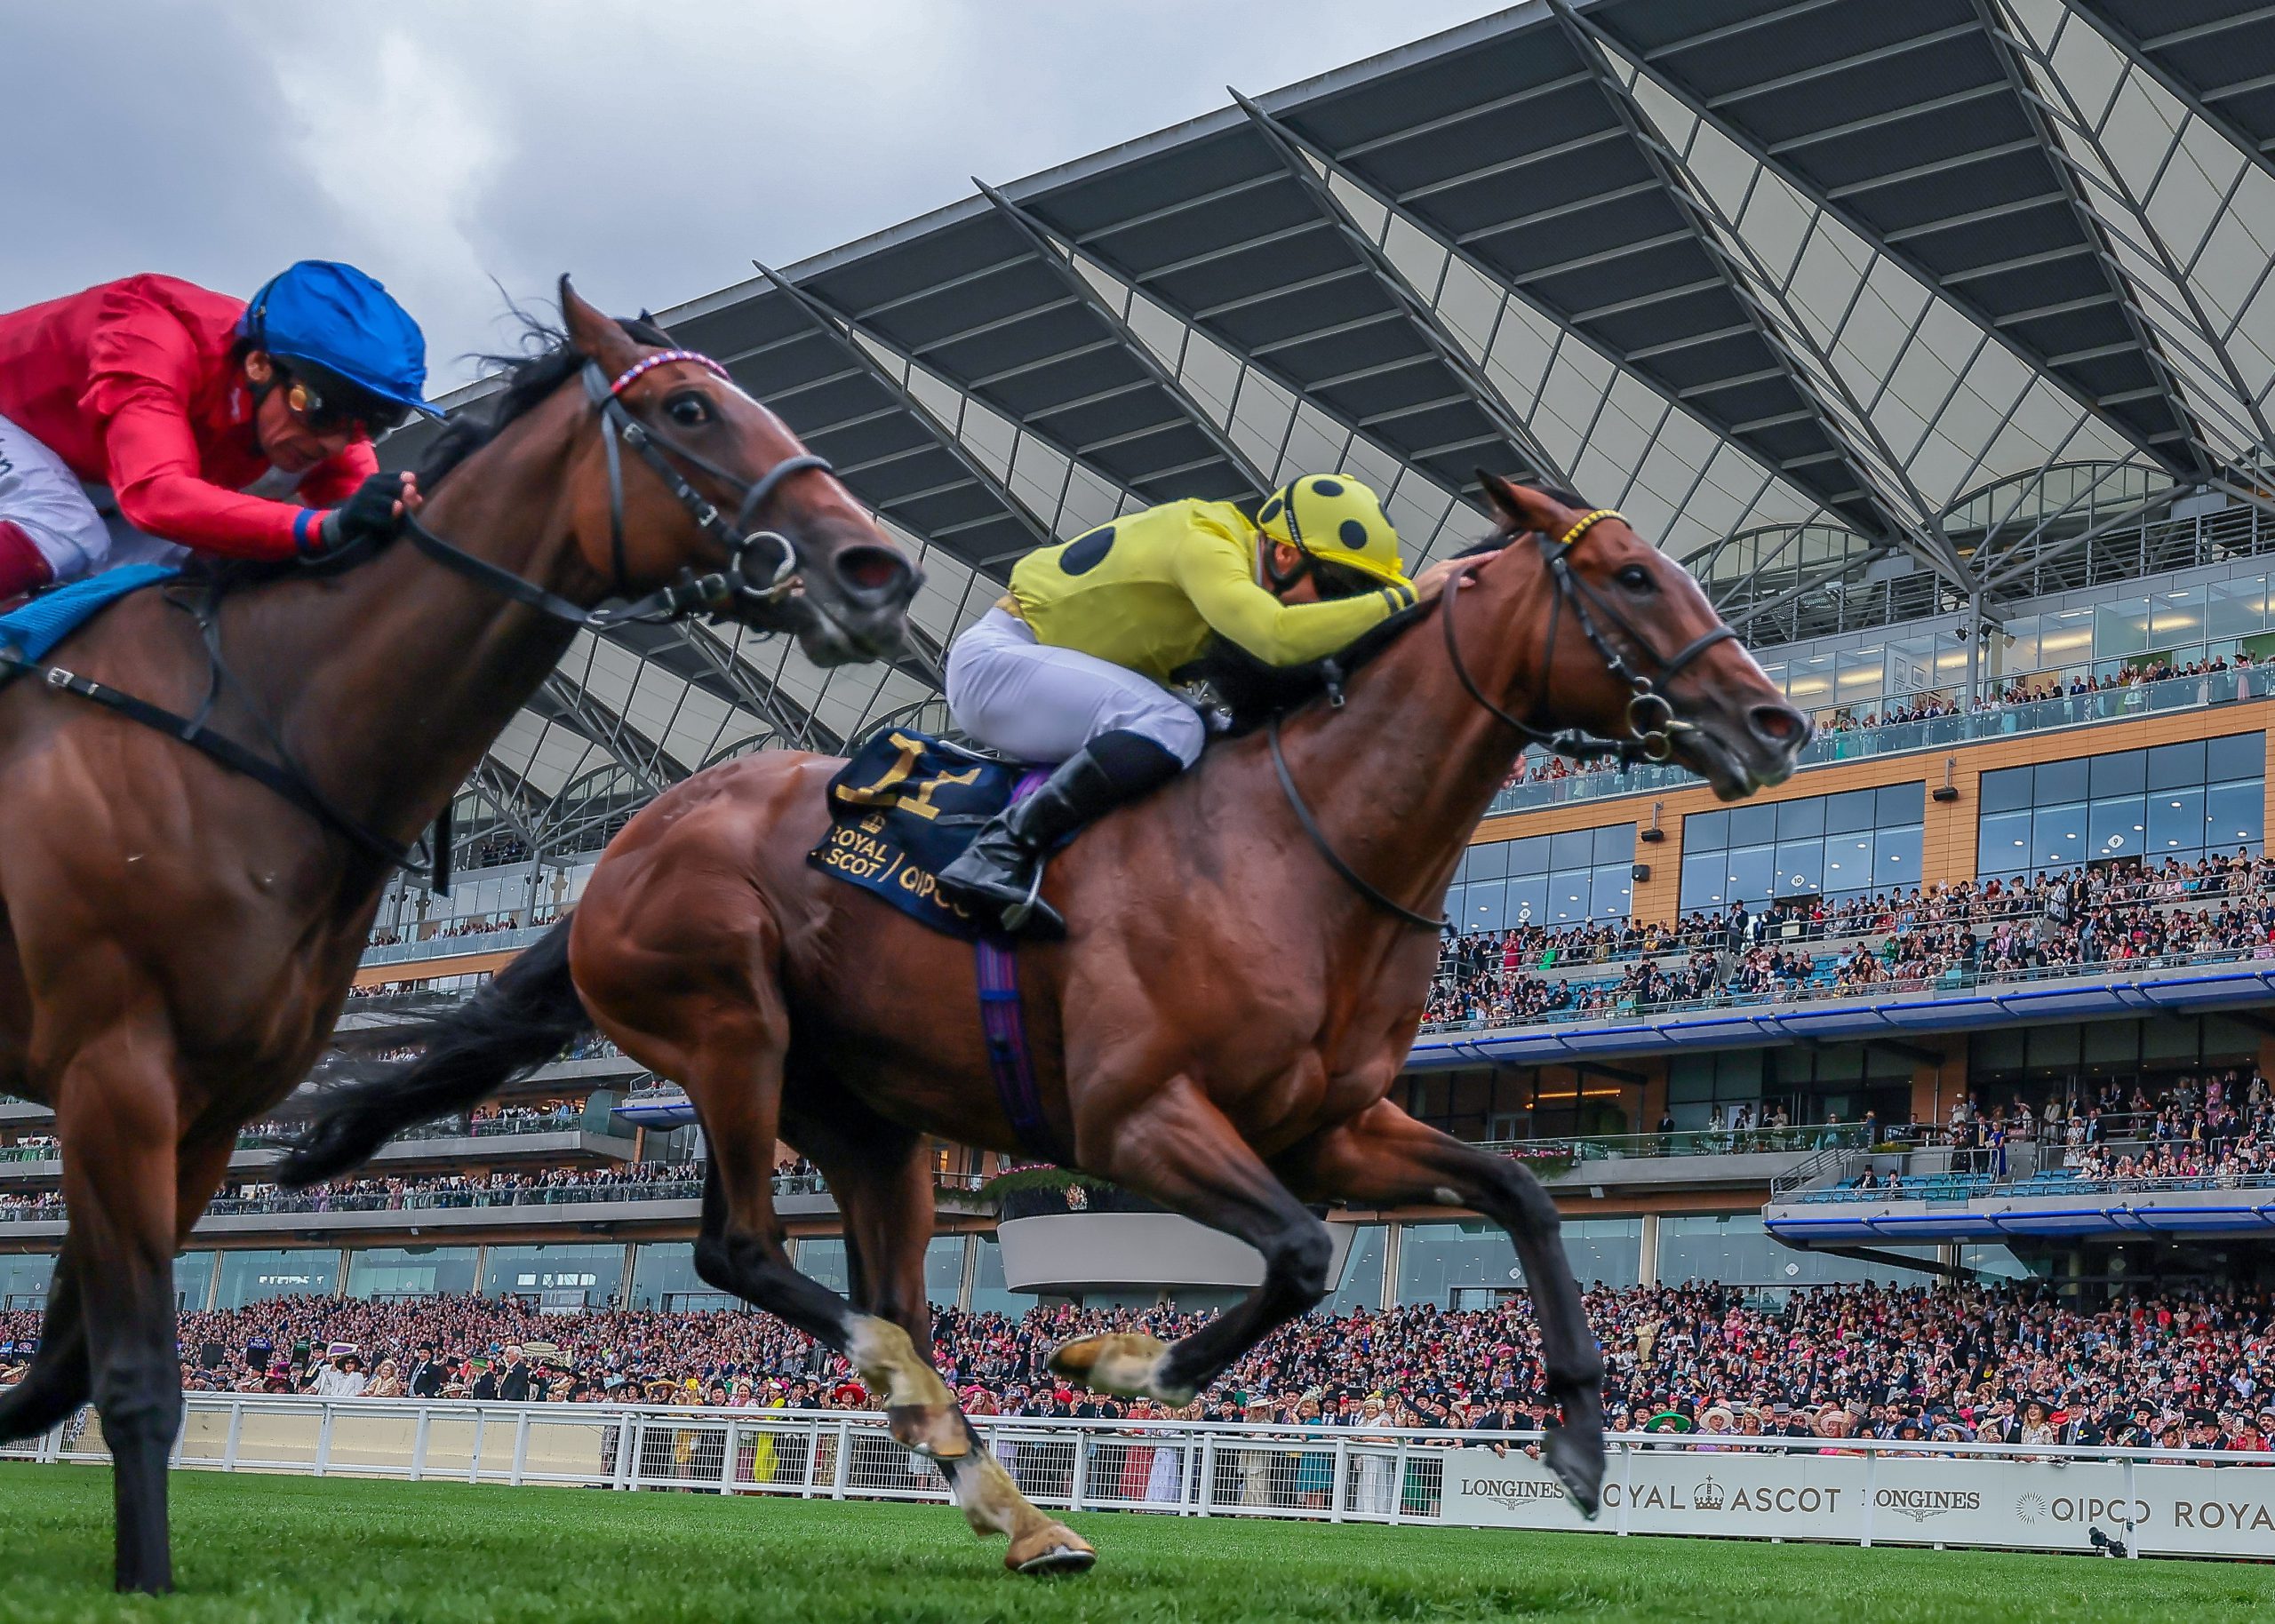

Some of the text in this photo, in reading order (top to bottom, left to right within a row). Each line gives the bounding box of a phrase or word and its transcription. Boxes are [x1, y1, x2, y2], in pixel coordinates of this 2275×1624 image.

[810, 848, 881, 878] SCOT
[1461, 1479, 1564, 1499] LONGINES
[1603, 1484, 1840, 1512] OYAL ASCOT
